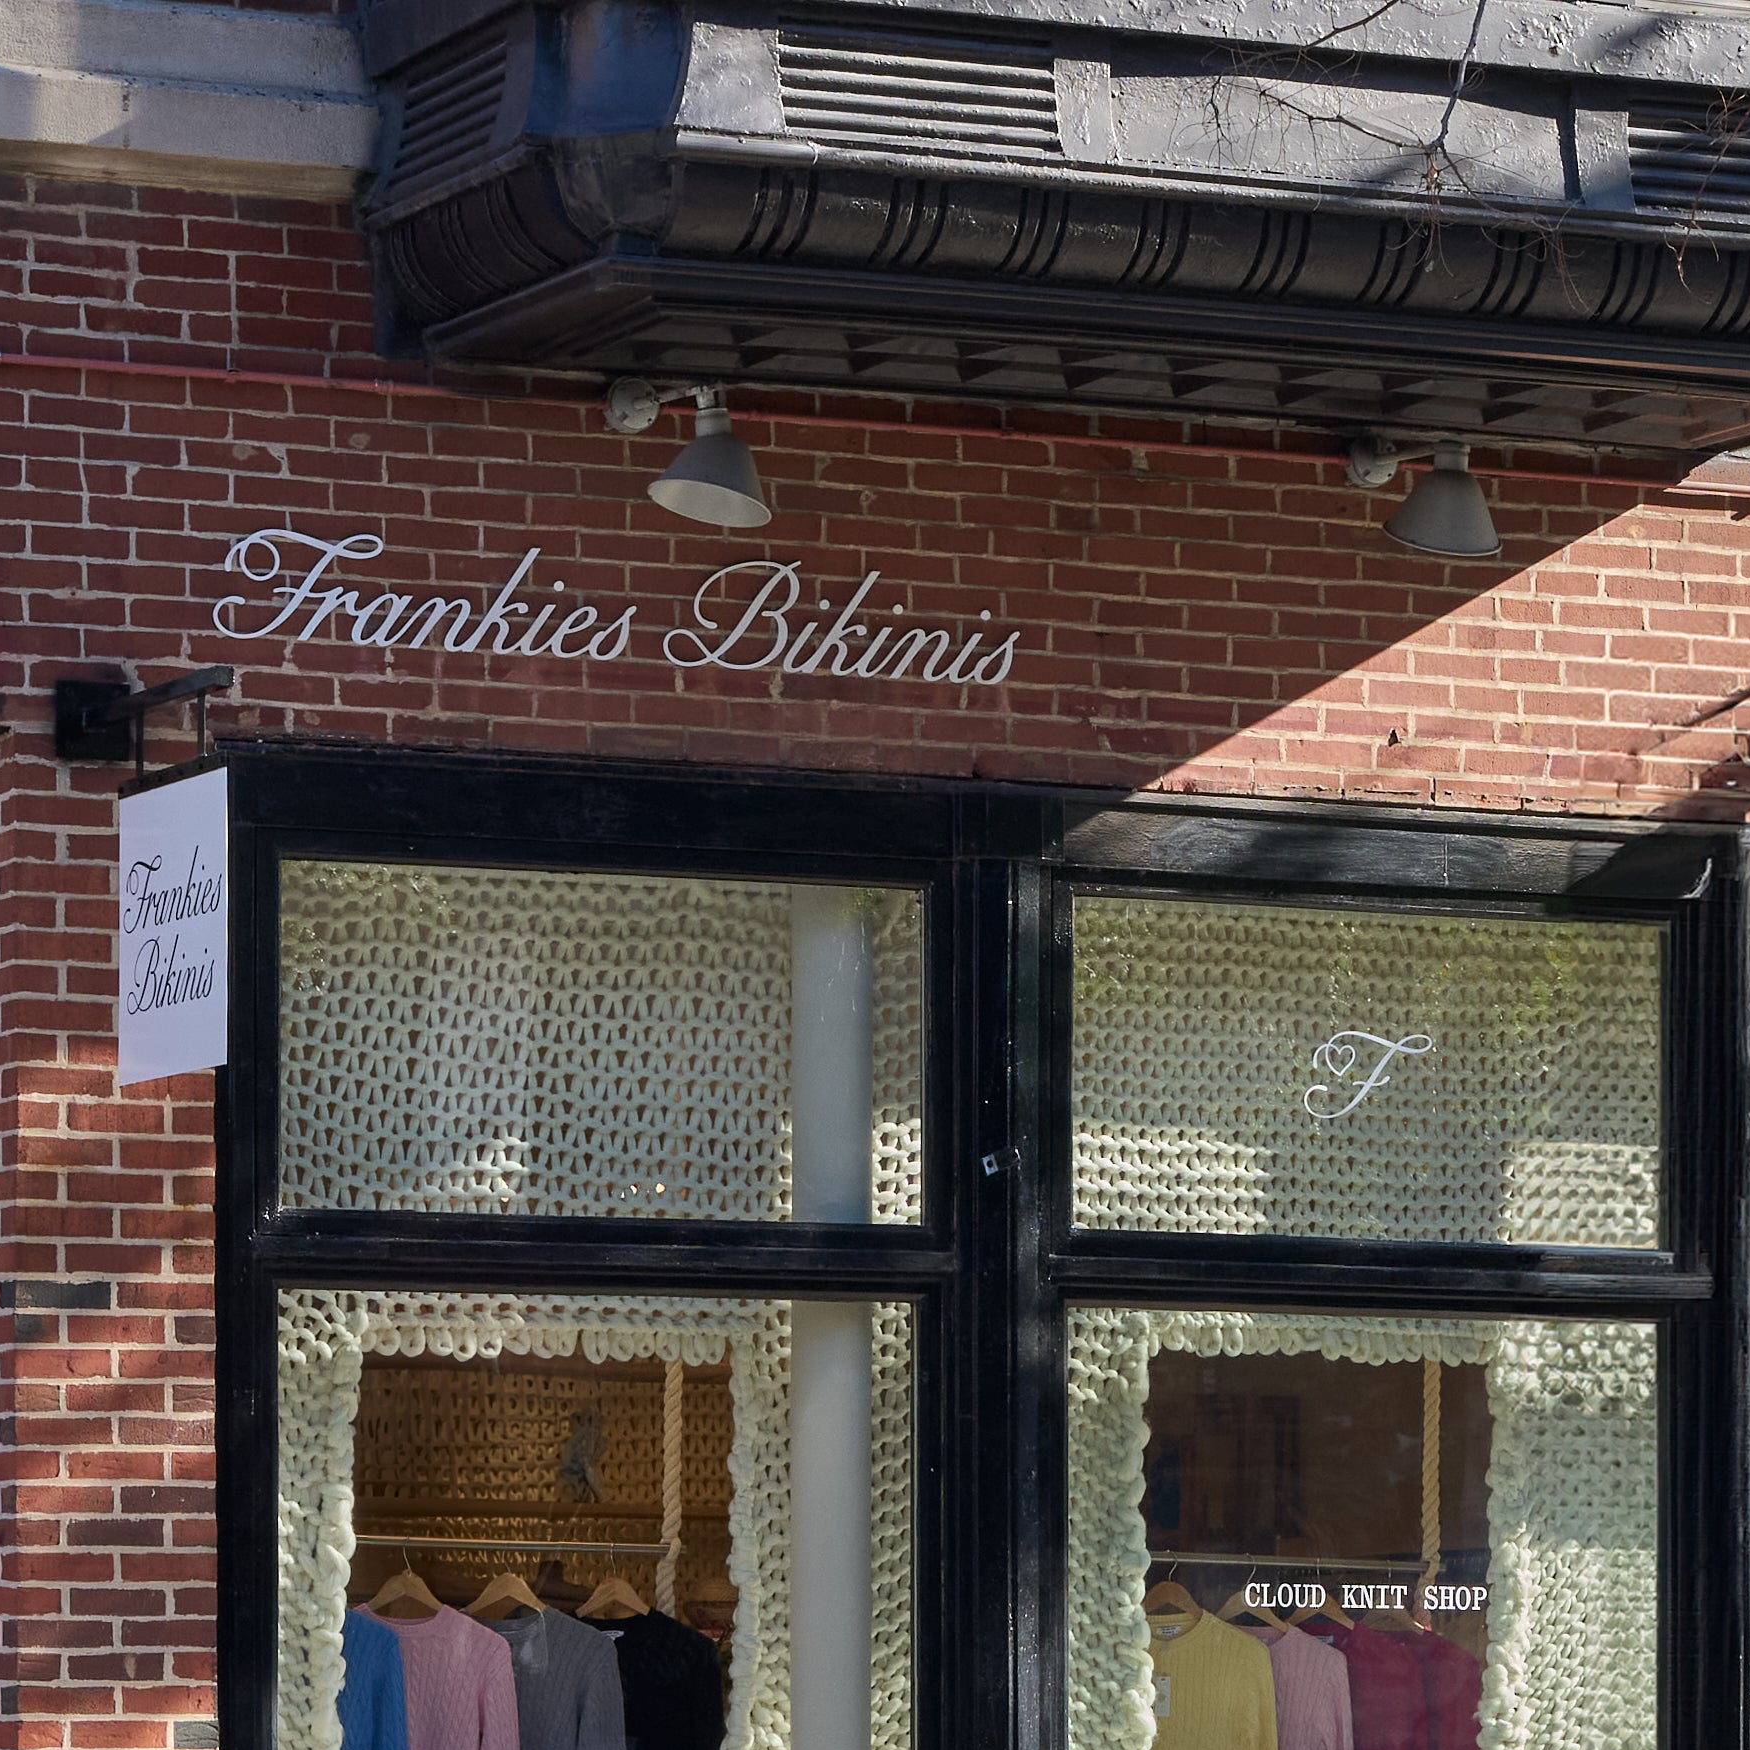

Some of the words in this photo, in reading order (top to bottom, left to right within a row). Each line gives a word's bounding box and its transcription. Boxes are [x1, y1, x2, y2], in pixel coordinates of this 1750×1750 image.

[212, 528, 638, 662] Frankies
[663, 560, 1021, 685] Bikinis
[123, 845, 223, 934] Frankies
[127, 934, 215, 1015] Bikinis
[1244, 1583, 1327, 1609] CLOUD
[1341, 1584, 1408, 1610] KNIT
[1423, 1586, 1488, 1611] SHOP
